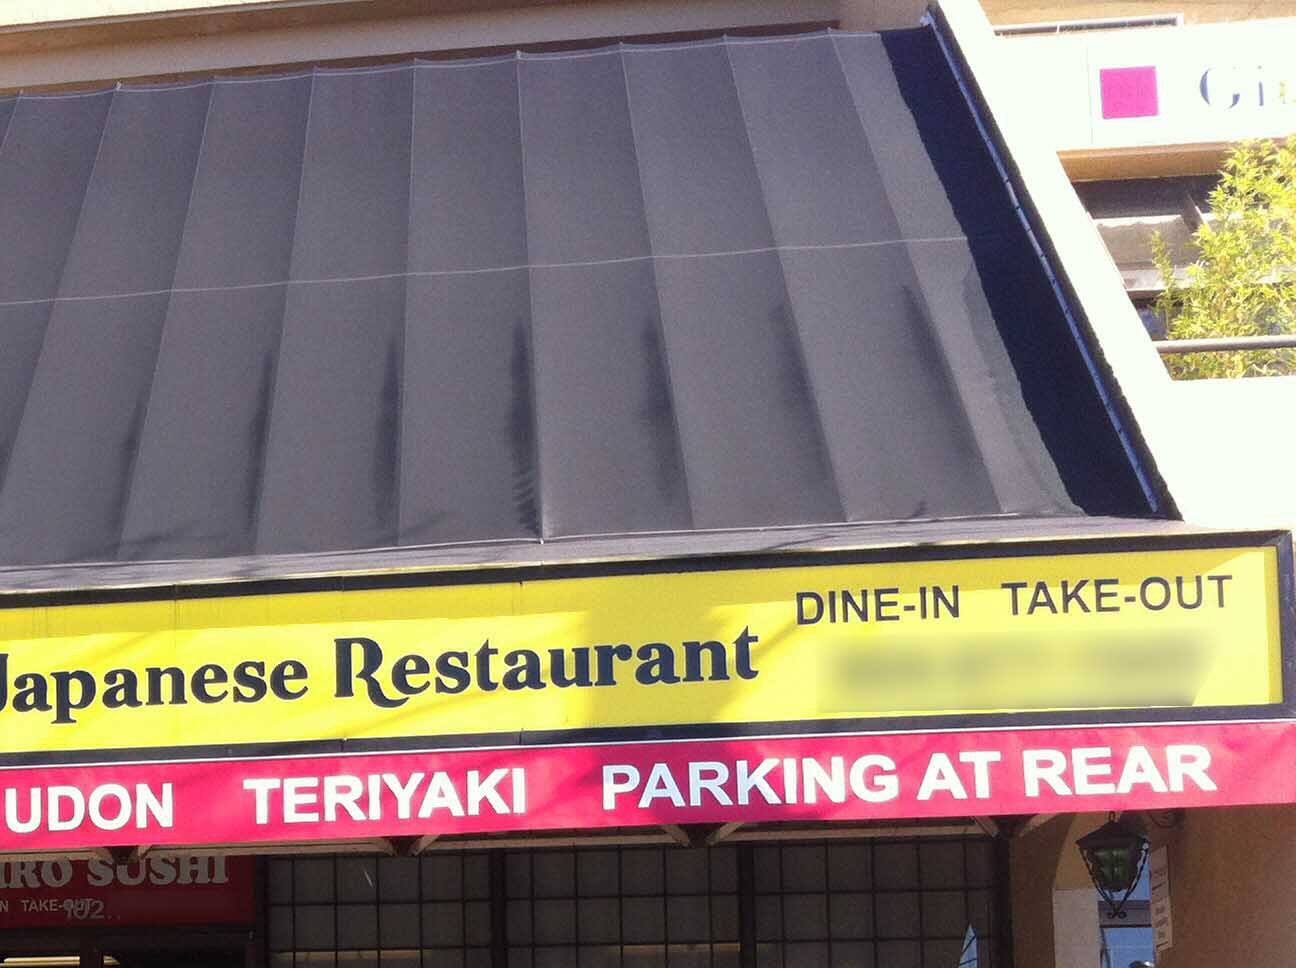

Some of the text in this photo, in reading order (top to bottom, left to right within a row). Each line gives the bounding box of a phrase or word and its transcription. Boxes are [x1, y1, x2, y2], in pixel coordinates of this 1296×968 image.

[795, 575, 1233, 625] DINE-IN TAKE-OUT
[334, 625, 759, 708] Restaurant
[5, 782, 174, 834] UDON
[243, 768, 527, 825] TERIYAKI
[601, 751, 899, 811] PARKING
[917, 749, 1001, 801] AT
[1021, 743, 1217, 796] REAR
[87, 855, 229, 886] SUSHI
